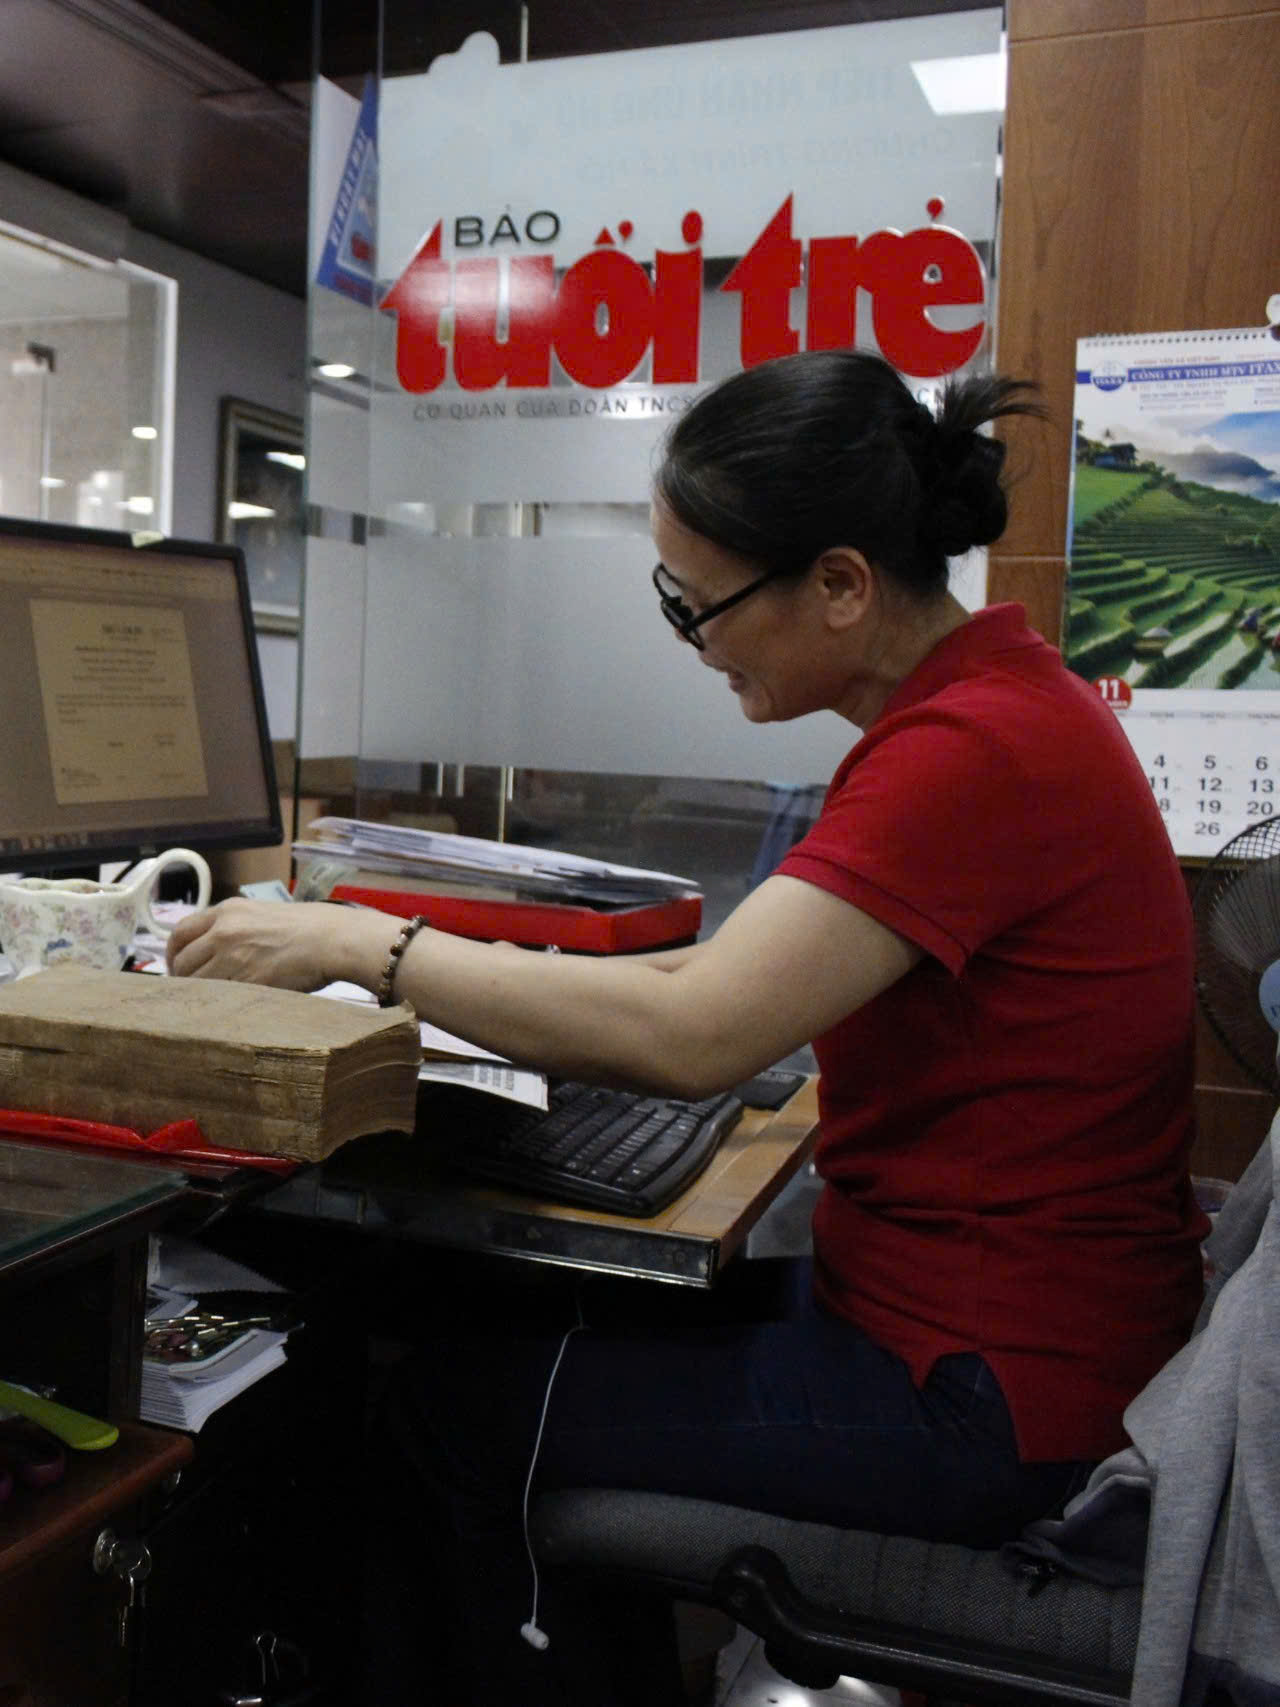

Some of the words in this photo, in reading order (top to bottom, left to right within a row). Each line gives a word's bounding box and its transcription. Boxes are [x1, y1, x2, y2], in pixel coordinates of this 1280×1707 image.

[720, 192, 986, 379] trẻ
[450, 400, 506, 421] QUAN
[1098, 678, 1120, 699] 11
[1154, 754, 1166, 768] 4
[1204, 754, 1217, 770] 5
[1255, 756, 1268, 771] 6
[1150, 775, 1169, 790] 11
[1199, 777, 1222, 792] 12
[1250, 779, 1274, 793] 13
[1159, 798, 1170, 812] 8
[1198, 800, 1222, 814] 19
[1247, 801, 1273, 816] 20
[1194, 822, 1220, 836] 26
